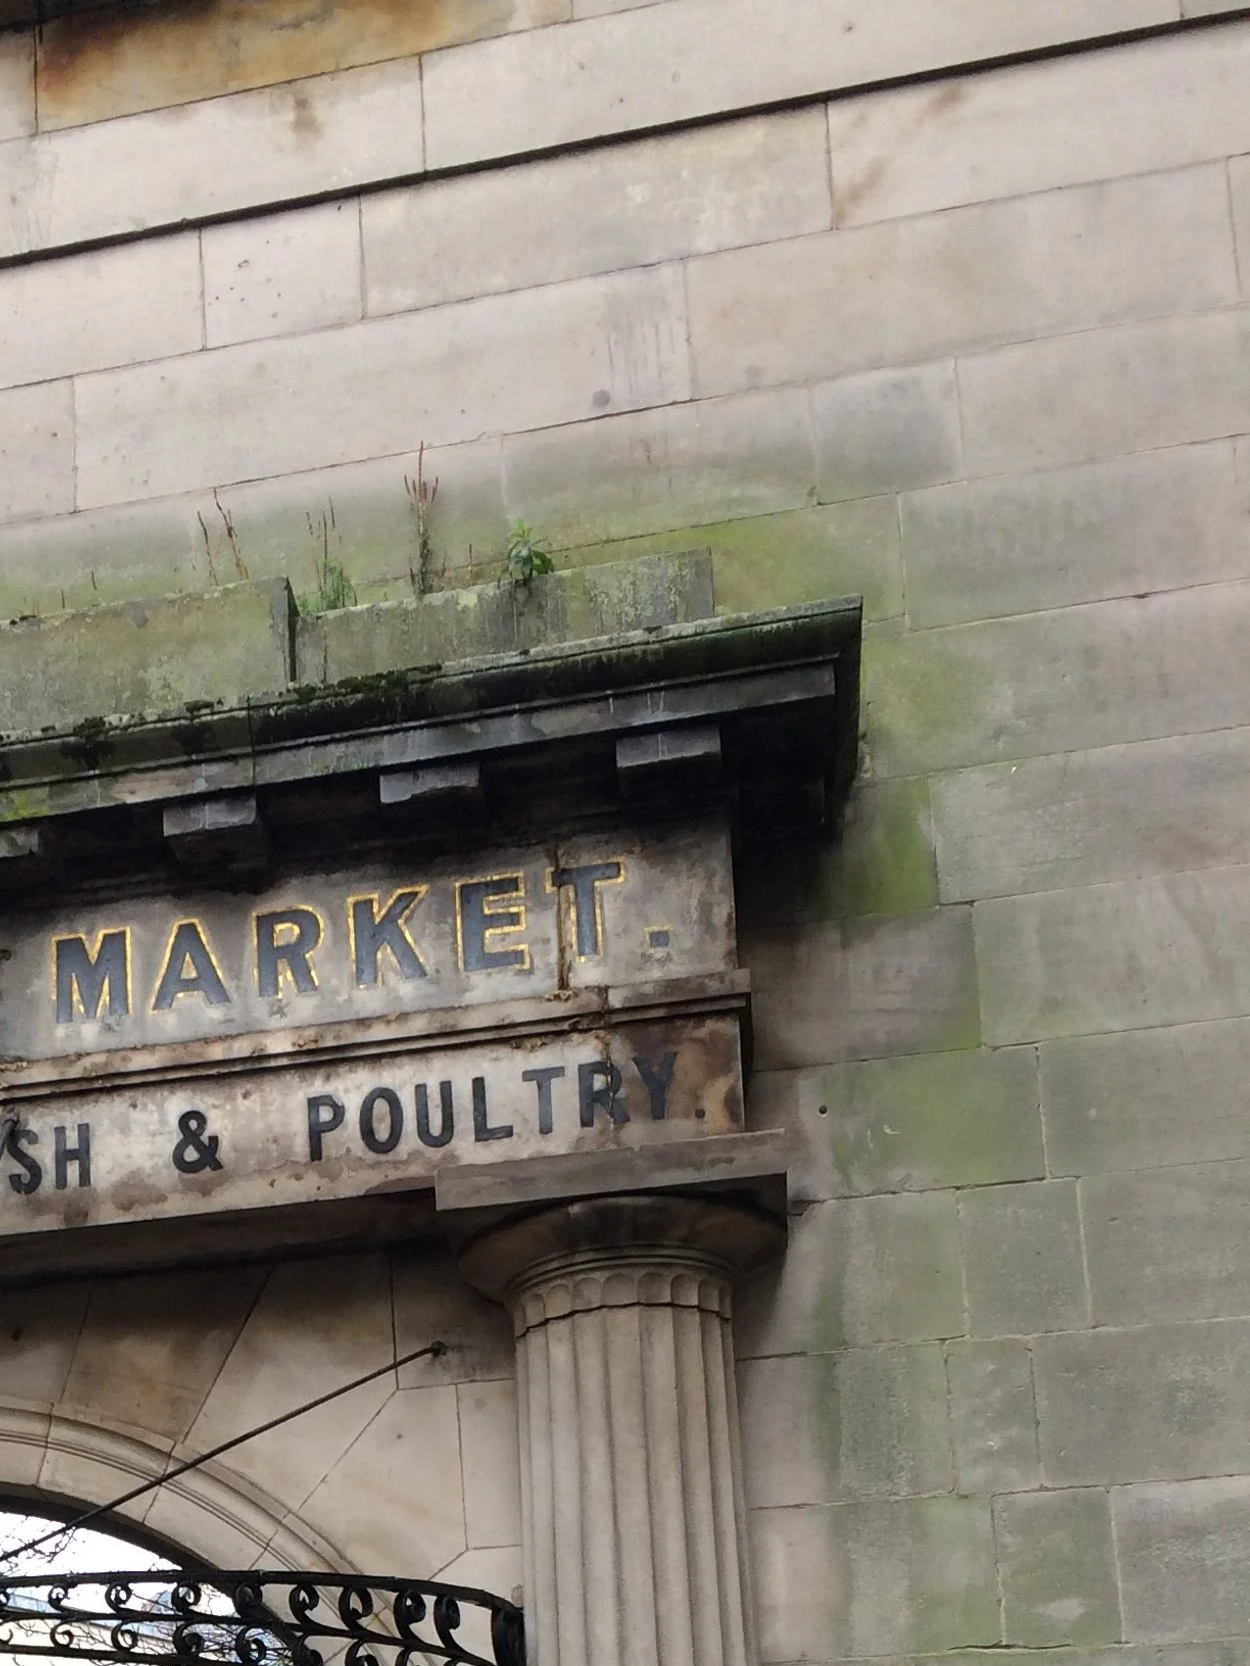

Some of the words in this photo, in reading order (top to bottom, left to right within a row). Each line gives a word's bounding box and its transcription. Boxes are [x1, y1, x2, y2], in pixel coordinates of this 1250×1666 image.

[51, 859, 673, 1024] MARKET.
[172, 1110, 224, 1174] &
[307, 1052, 706, 1161] POULTRY.
